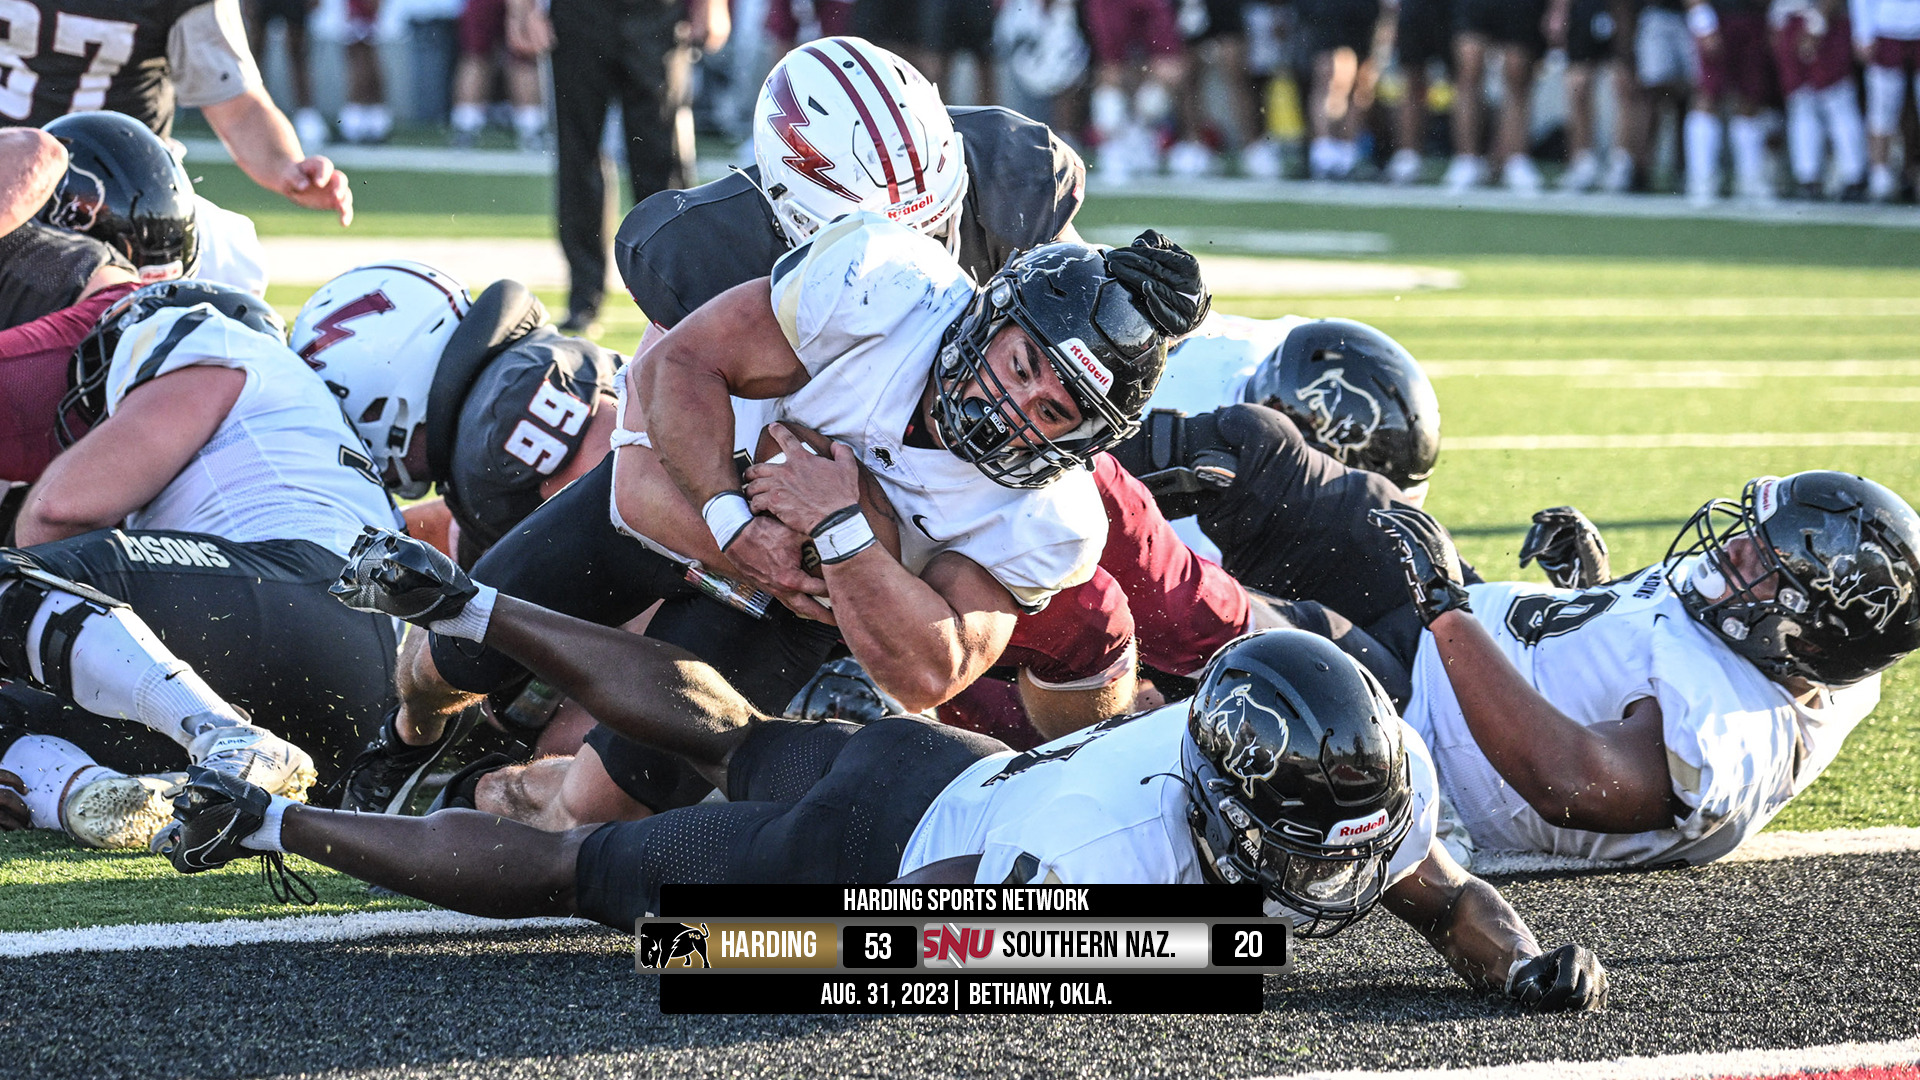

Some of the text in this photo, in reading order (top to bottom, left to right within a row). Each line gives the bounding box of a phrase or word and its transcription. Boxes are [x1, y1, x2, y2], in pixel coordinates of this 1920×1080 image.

[1070, 345, 1110, 386] Riddell
[504, 379, 591, 475] 99
[1340, 815, 1386, 837] Riddell
